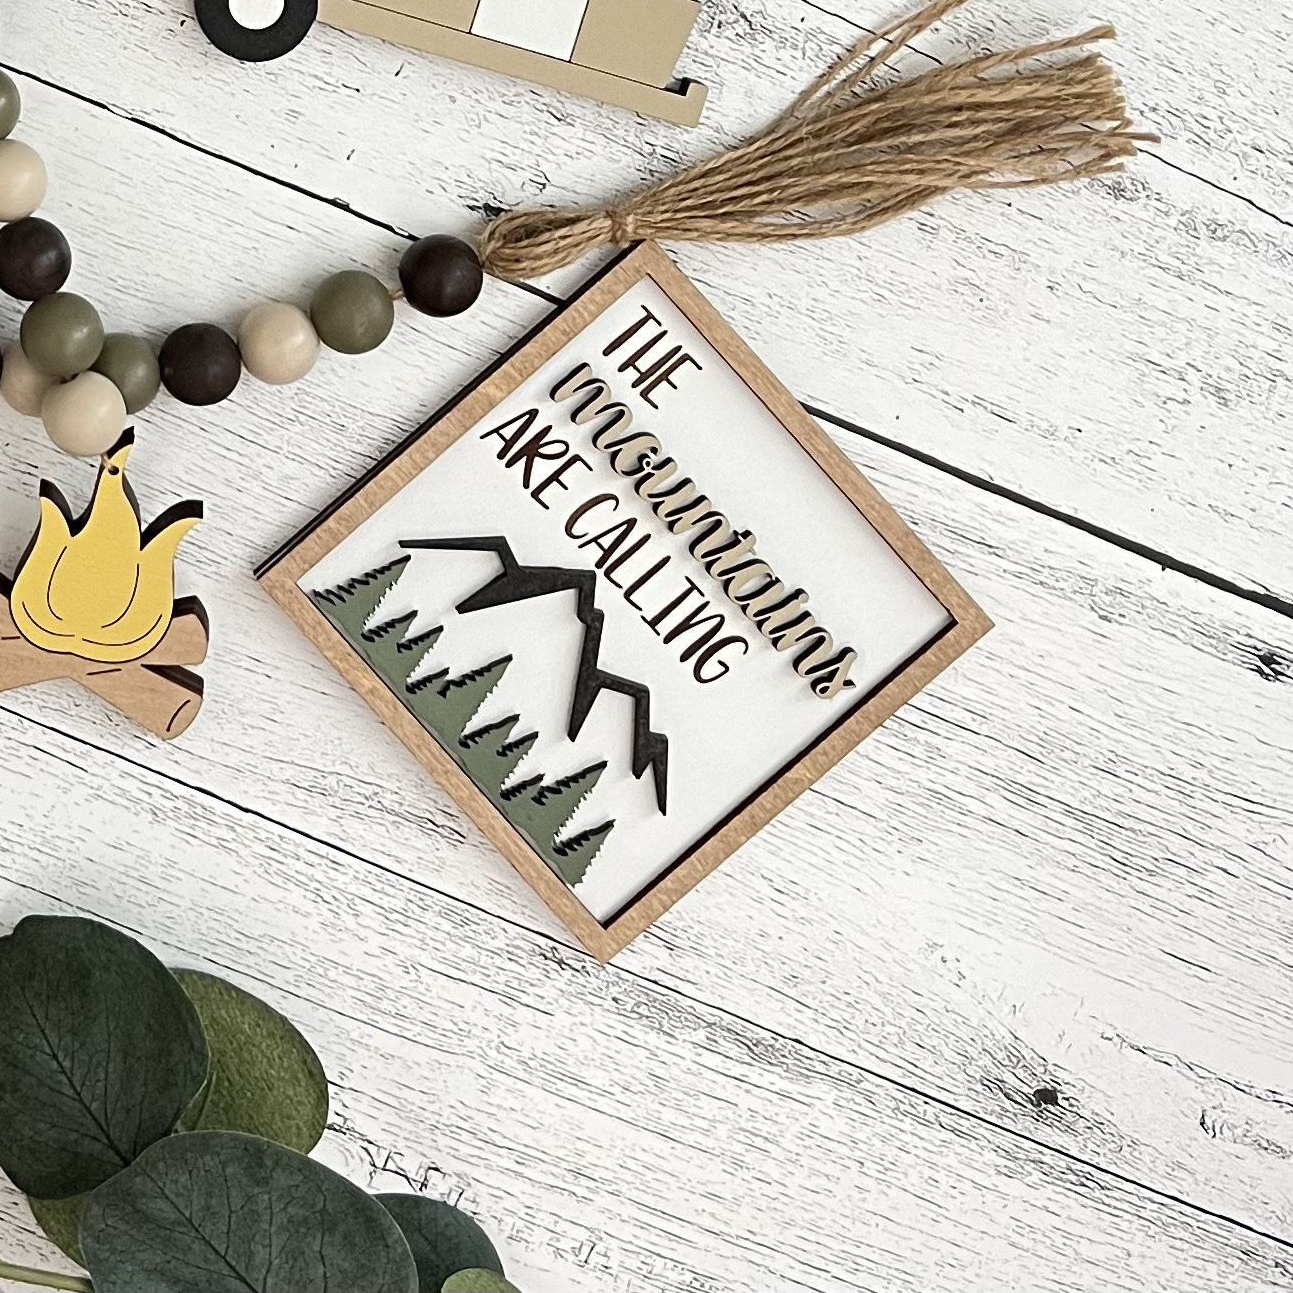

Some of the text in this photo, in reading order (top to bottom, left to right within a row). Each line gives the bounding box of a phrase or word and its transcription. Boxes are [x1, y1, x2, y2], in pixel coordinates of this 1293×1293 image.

[602, 304, 703, 410] THE
[479, 408, 750, 685] ARE CALLING
[548, 360, 858, 700] mountains
